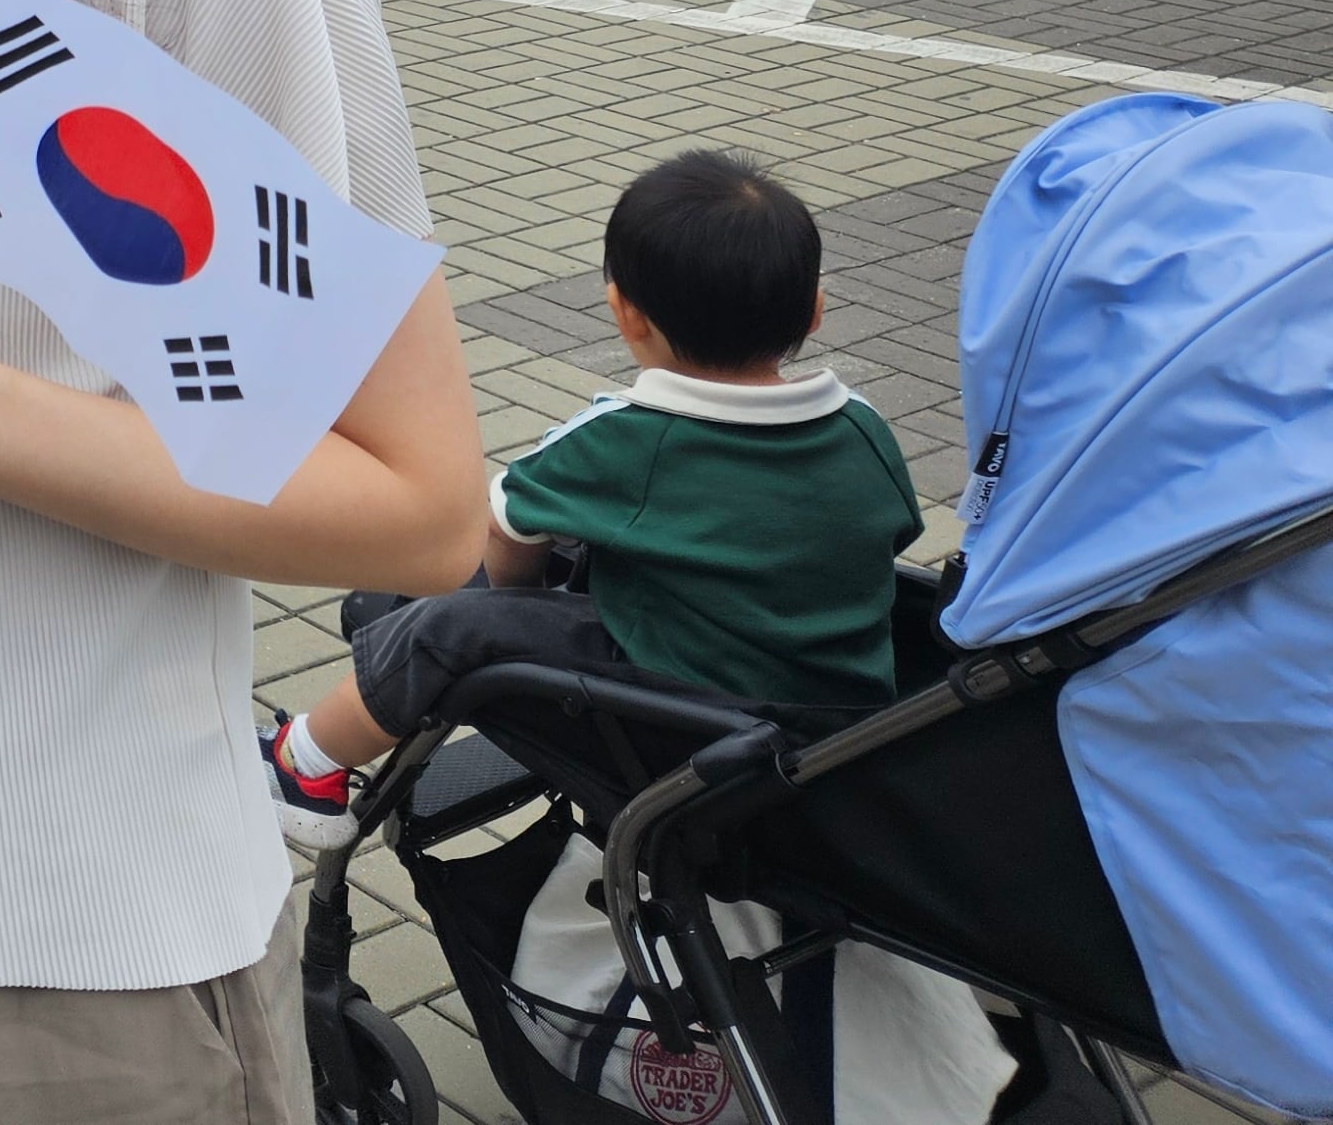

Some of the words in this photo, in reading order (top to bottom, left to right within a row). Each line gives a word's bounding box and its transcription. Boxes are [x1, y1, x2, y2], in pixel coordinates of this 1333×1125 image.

[987, 442, 1006, 472] TAVO
[641, 1065, 718, 1094] TRADER
[651, 1088, 708, 1114] JOE'S
